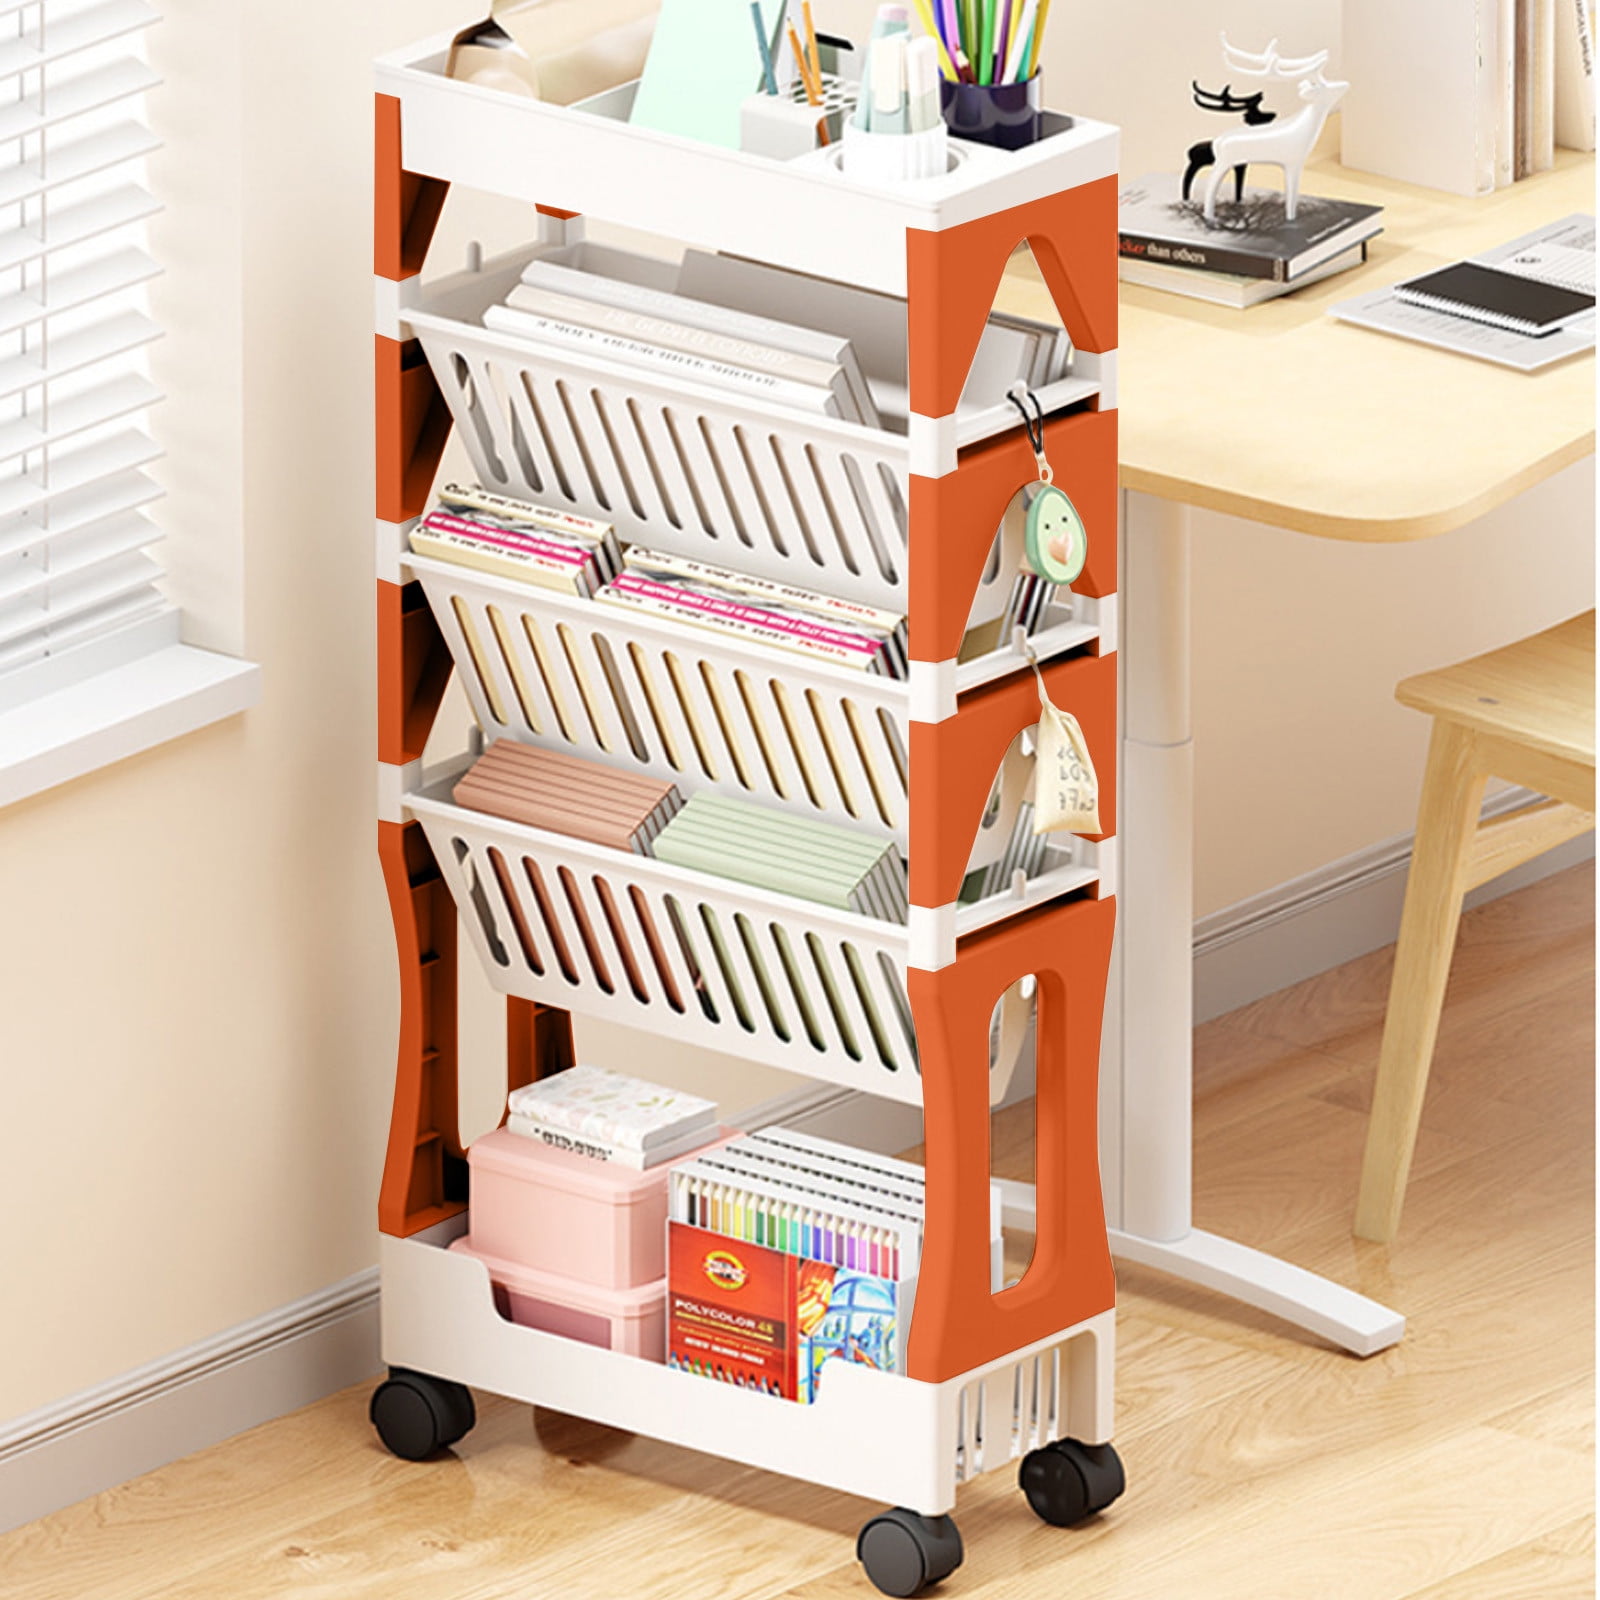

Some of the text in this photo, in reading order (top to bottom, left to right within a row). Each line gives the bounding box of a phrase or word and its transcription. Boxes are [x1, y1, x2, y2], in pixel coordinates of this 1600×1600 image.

[1147, 243, 1170, 259] than
[1172, 247, 1206, 264] others
[675, 1299, 756, 1328] POLYCOLOR
